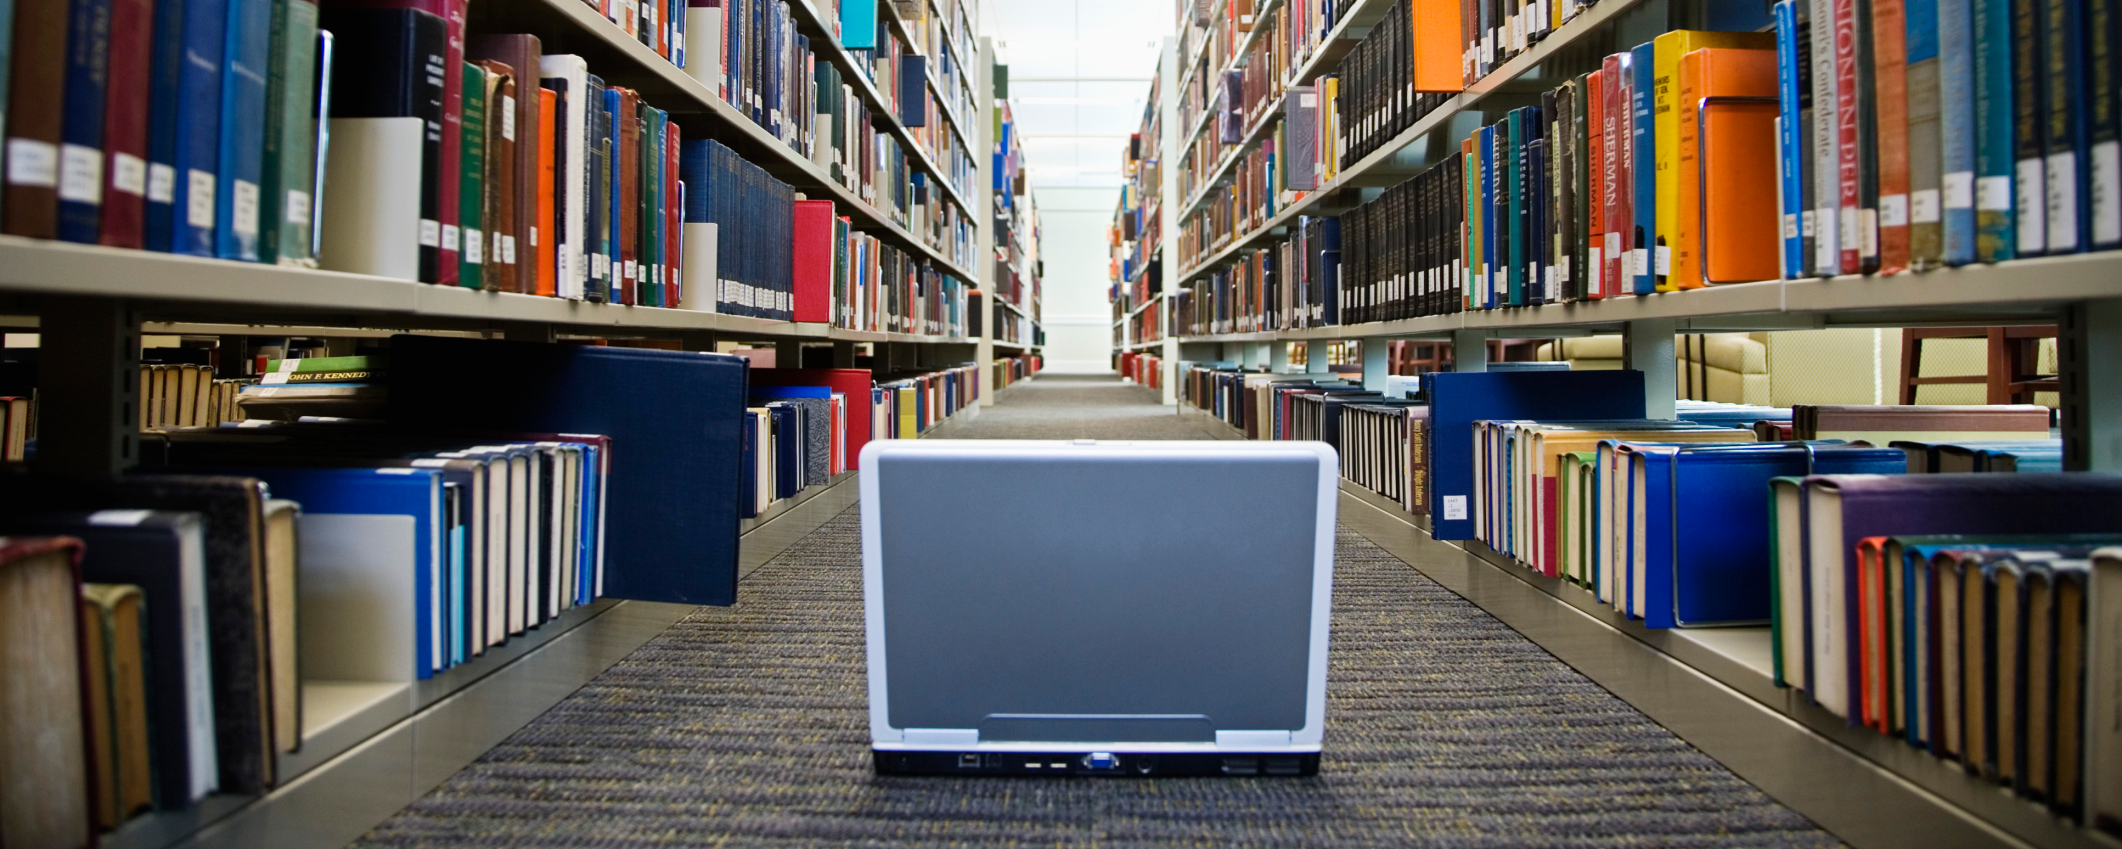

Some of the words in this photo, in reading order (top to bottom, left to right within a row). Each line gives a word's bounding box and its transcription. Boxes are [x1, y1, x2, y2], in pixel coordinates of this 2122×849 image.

[1817, 59, 1833, 157] Confederate
[1839, 95, 1855, 128] IN
[1622, 101, 1631, 169] SHERMAN
[1605, 116, 1617, 207] SHERMAN
[288, 373, 314, 381] OHN
[322, 371, 373, 380] KENNEDY
[1414, 432, 1423, 444] Scott
[1414, 444, 1423, 463] Anderson
[1414, 469, 1424, 485] Dwight
[1414, 485, 1424, 506] Anderson
